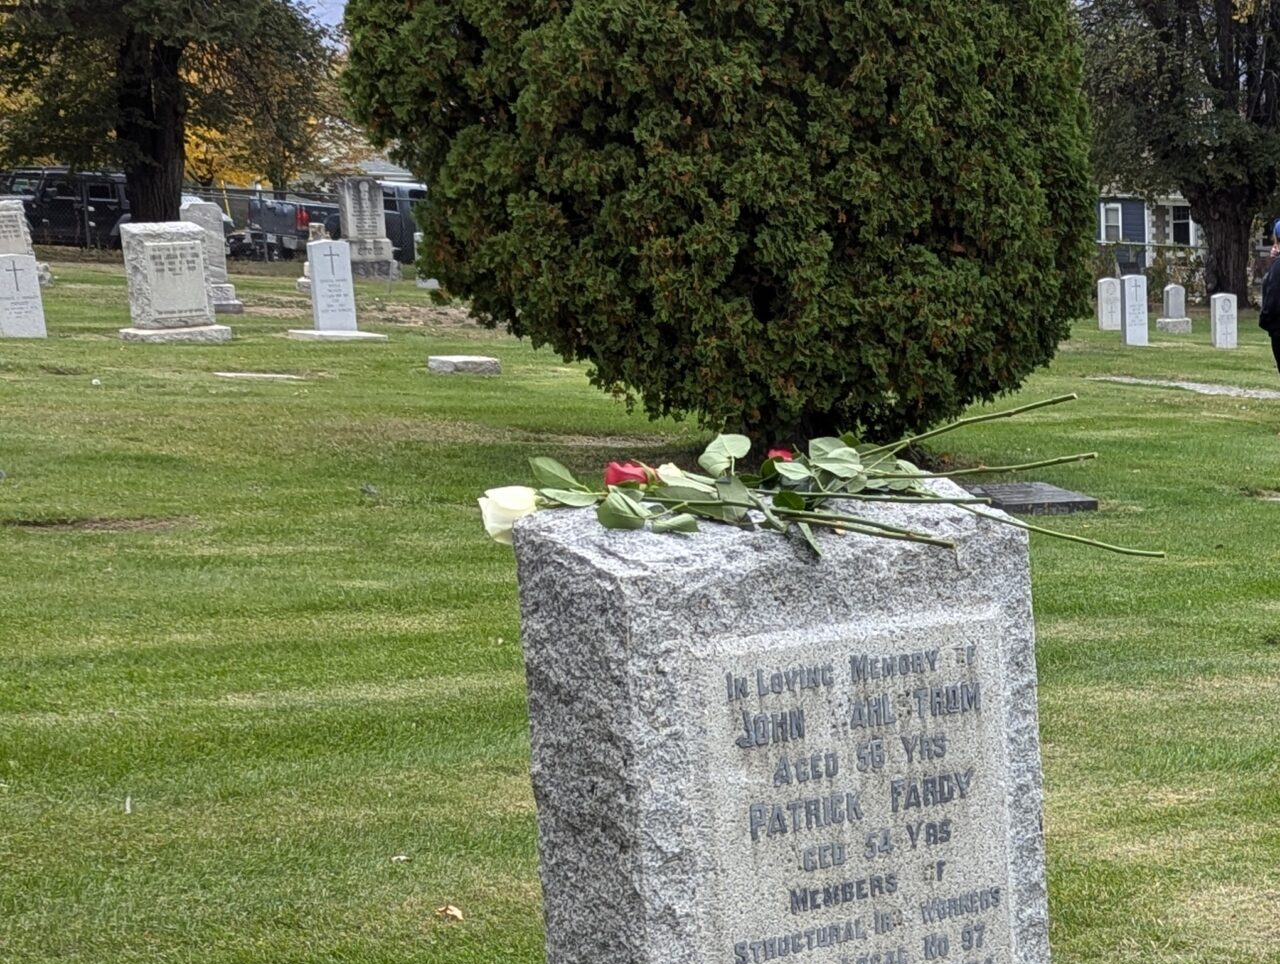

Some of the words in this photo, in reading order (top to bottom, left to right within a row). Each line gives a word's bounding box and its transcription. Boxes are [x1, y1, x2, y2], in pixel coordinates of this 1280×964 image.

[736, 706, 805, 749] JOHN
[774, 751, 839, 788] AGED
[901, 735, 948, 763] YRS
[750, 789, 863, 841] PATRICK
[891, 767, 975, 812] FARDY
[793, 842, 846, 873] GED
[864, 828, 894, 860] 54
[906, 818, 952, 849] YRS
[789, 873, 898, 915] MEMBERS
[921, 886, 1000, 924] WORKERS
[961, 923, 986, 951] 97
